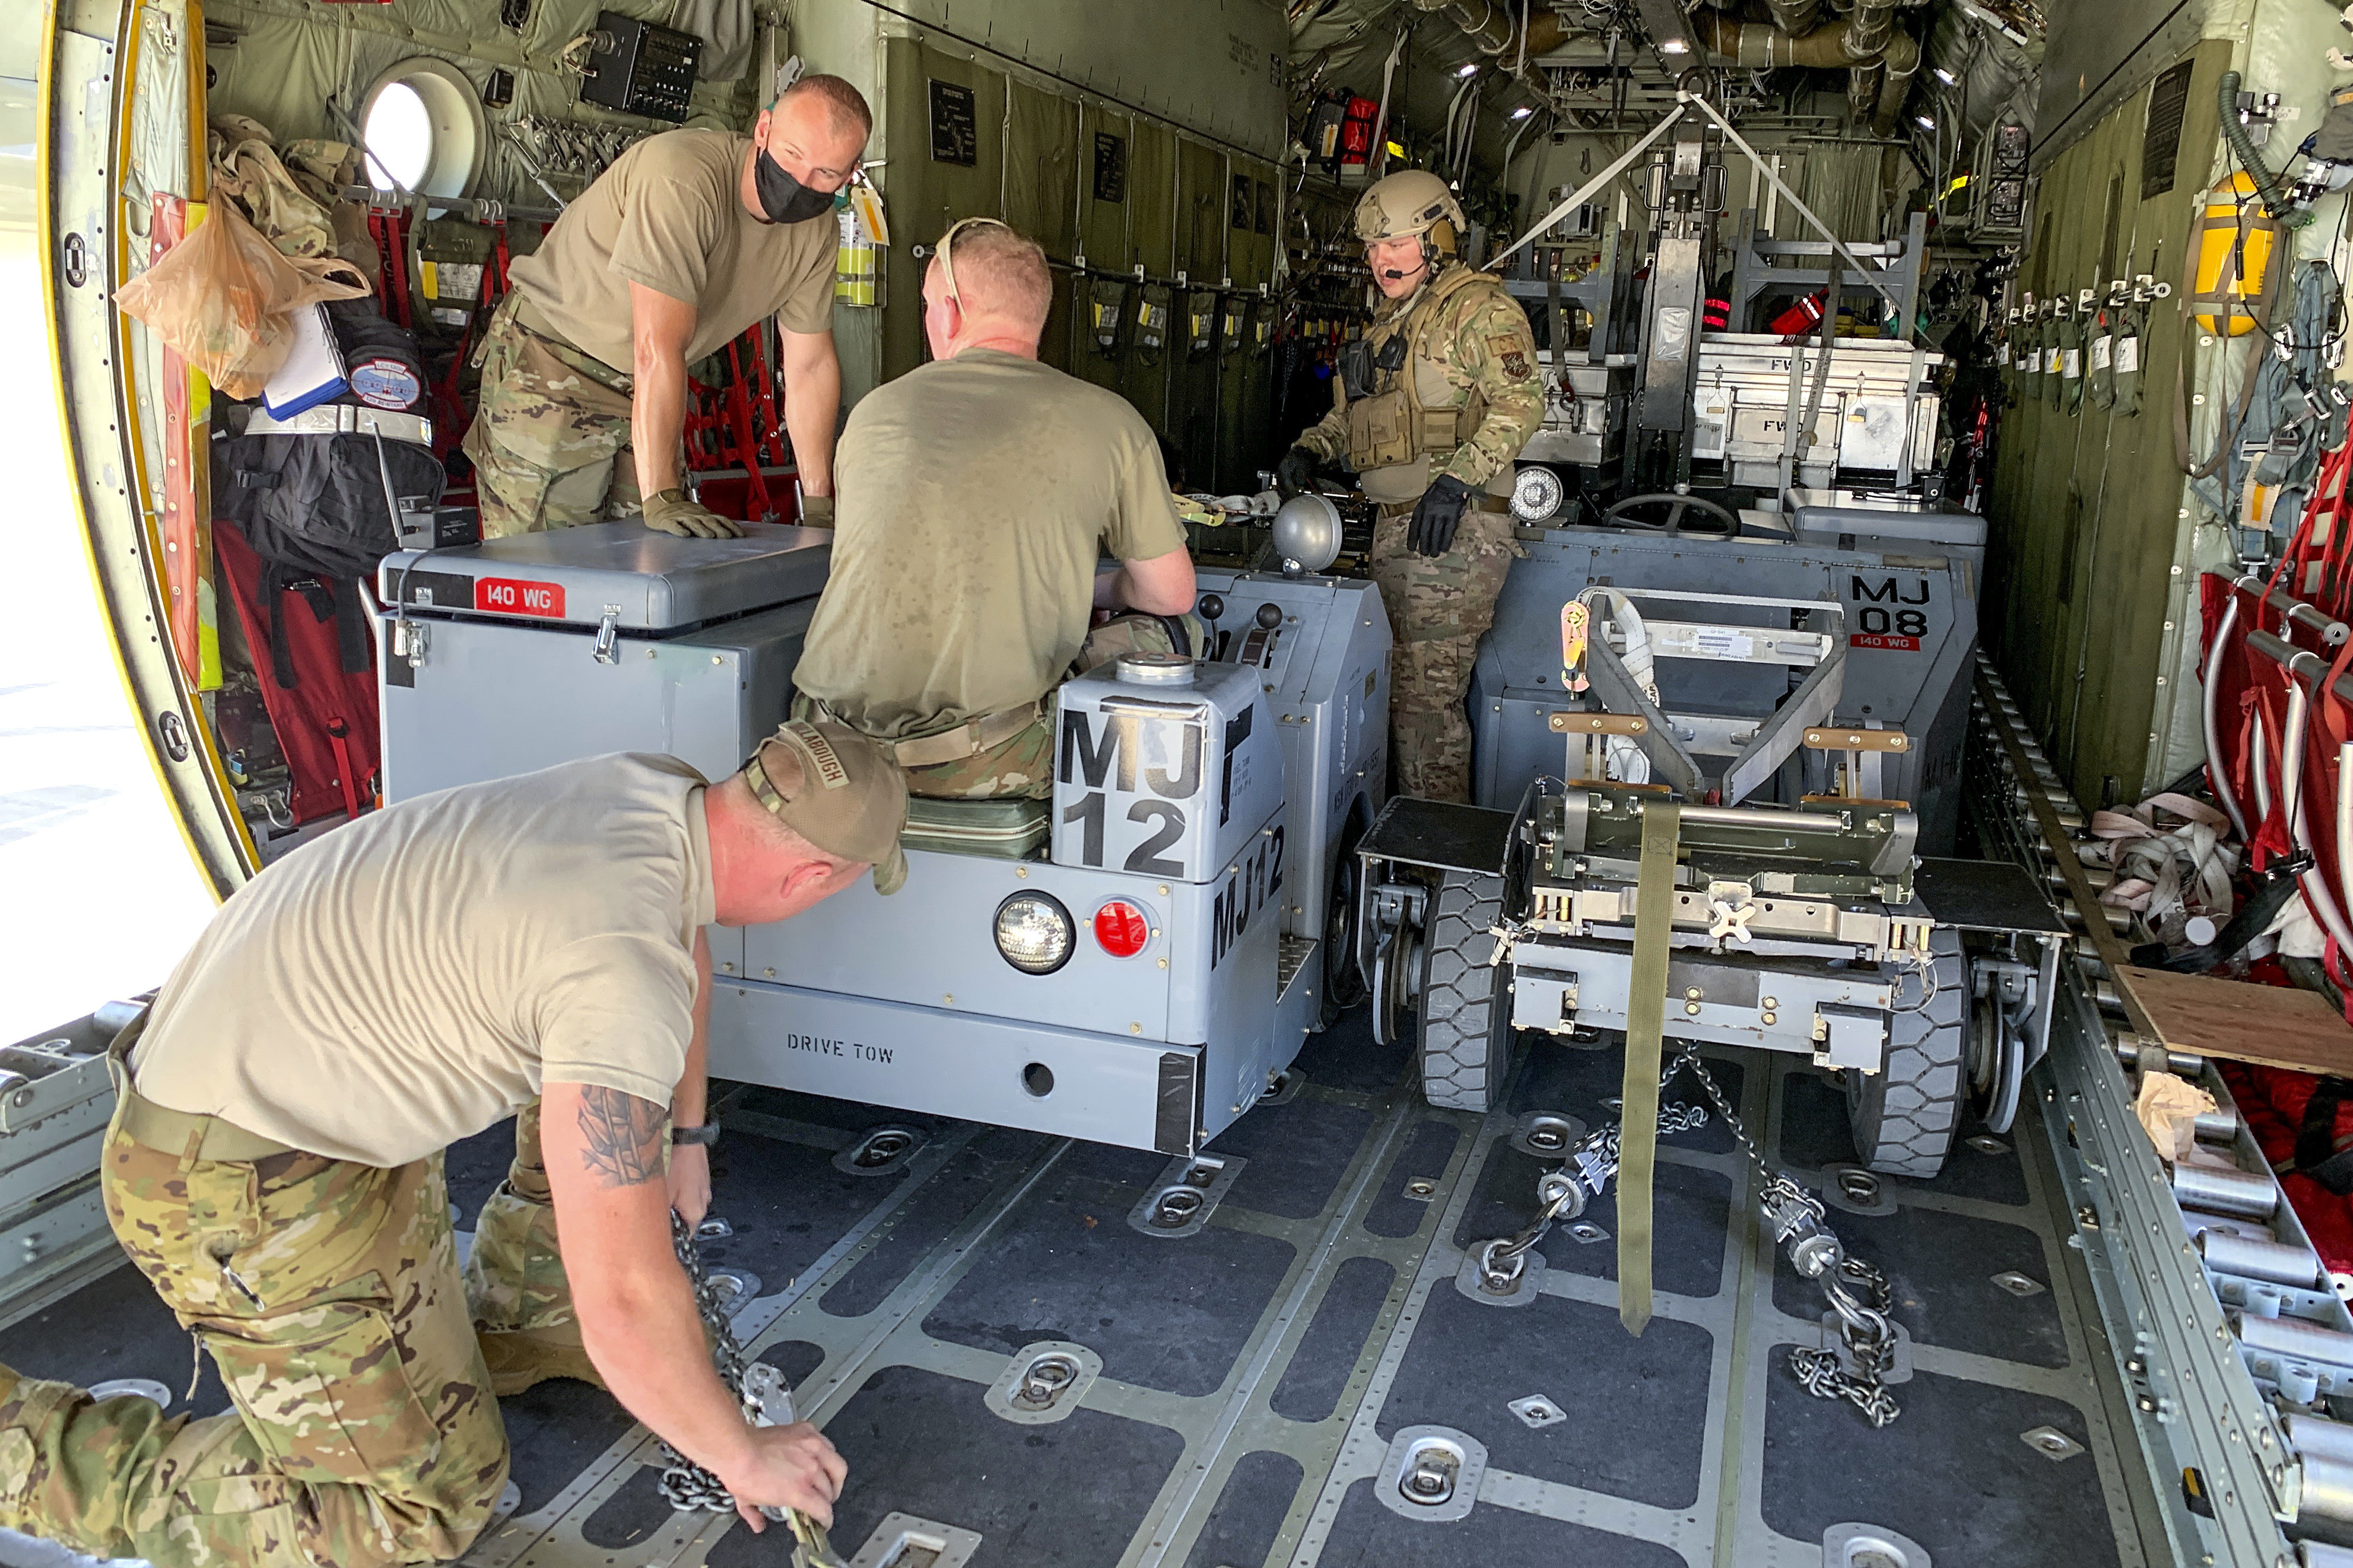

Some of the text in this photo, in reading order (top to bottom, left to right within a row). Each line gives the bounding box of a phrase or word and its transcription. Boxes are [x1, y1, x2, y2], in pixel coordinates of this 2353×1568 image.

[487, 584, 551, 609] 140 WG
[1852, 575, 1930, 605] MJ
[1859, 607, 1928, 638] 08
[1860, 636, 1910, 648] 140 WG
[1057, 708, 1205, 800] MJ
[1063, 791, 1186, 878] 12
[1211, 824, 1285, 972] MJ12
[787, 1033, 893, 1064] DRIVE TOW
